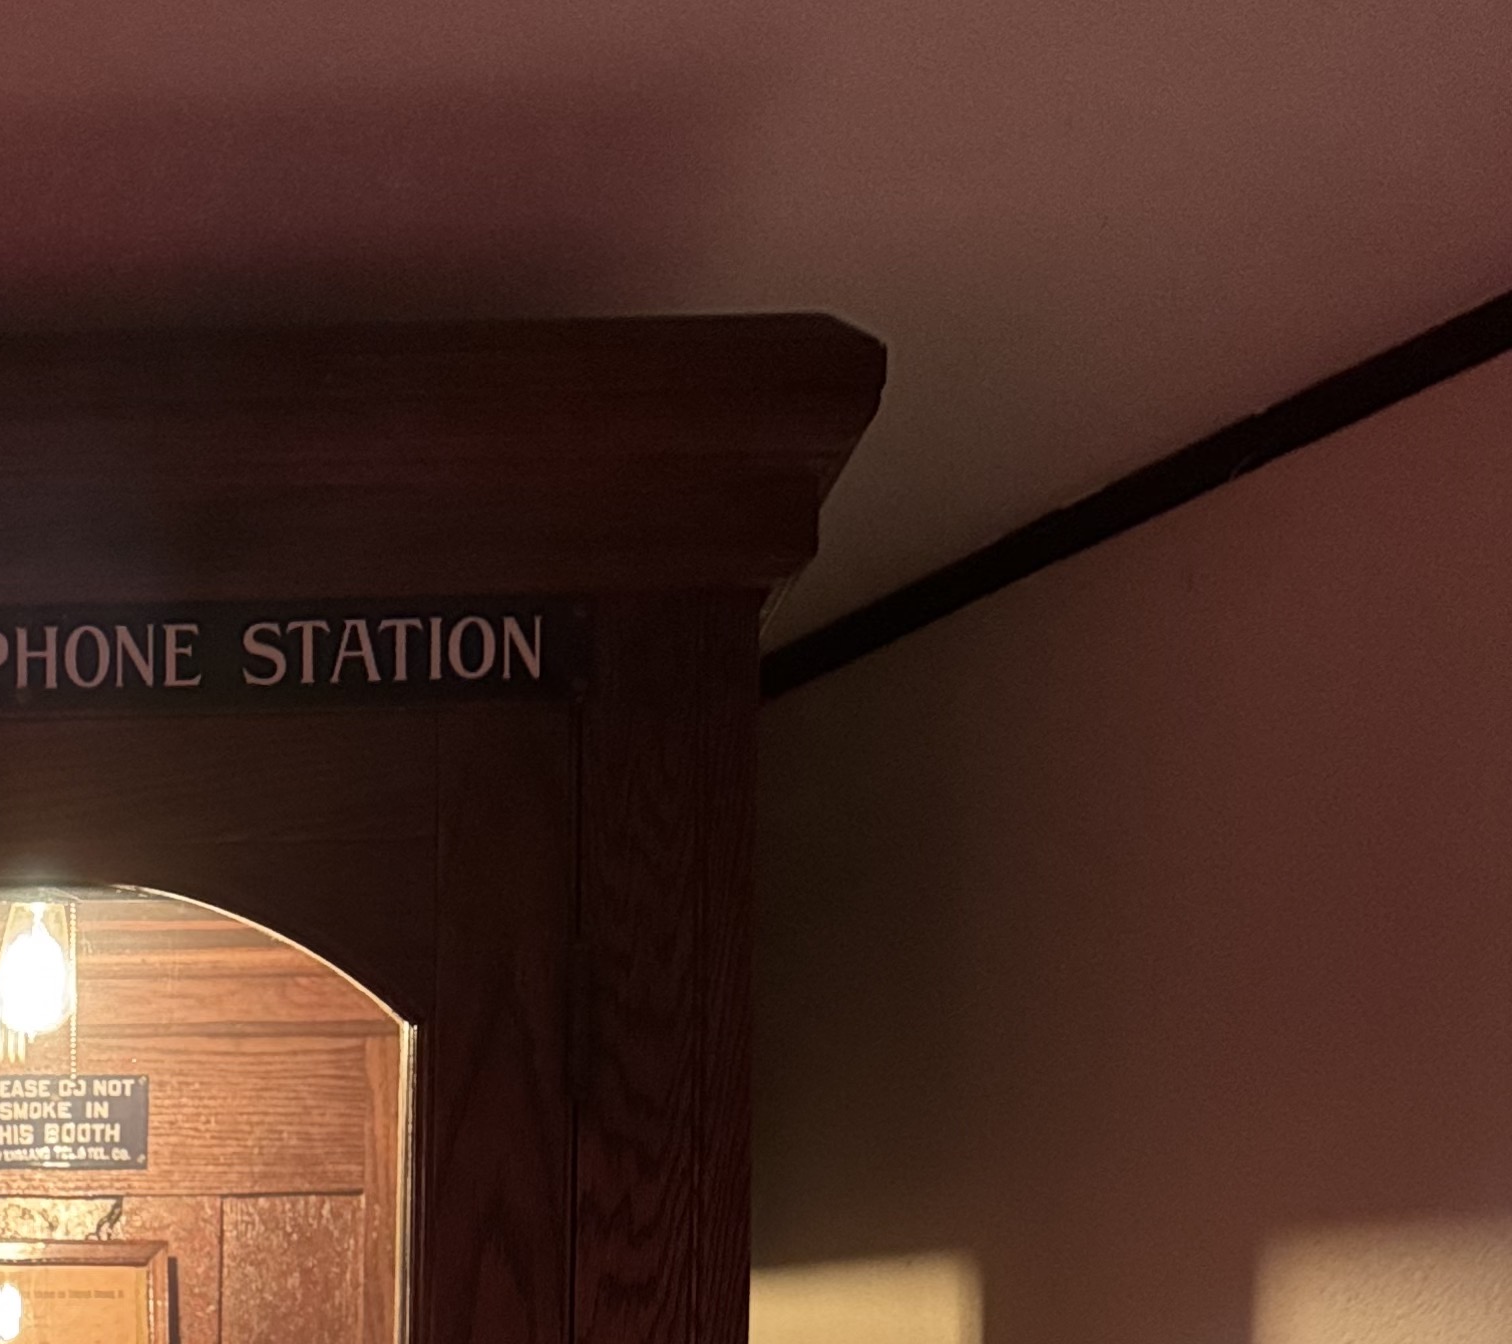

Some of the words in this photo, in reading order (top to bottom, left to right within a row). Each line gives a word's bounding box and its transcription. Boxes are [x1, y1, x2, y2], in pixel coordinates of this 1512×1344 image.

[242, 615, 543, 686] STATION
[58, 1079, 87, 1097] DO
[93, 1078, 135, 1097] NOT
[85, 1101, 109, 1119] IN
[44, 1121, 121, 1144] BOOTH
